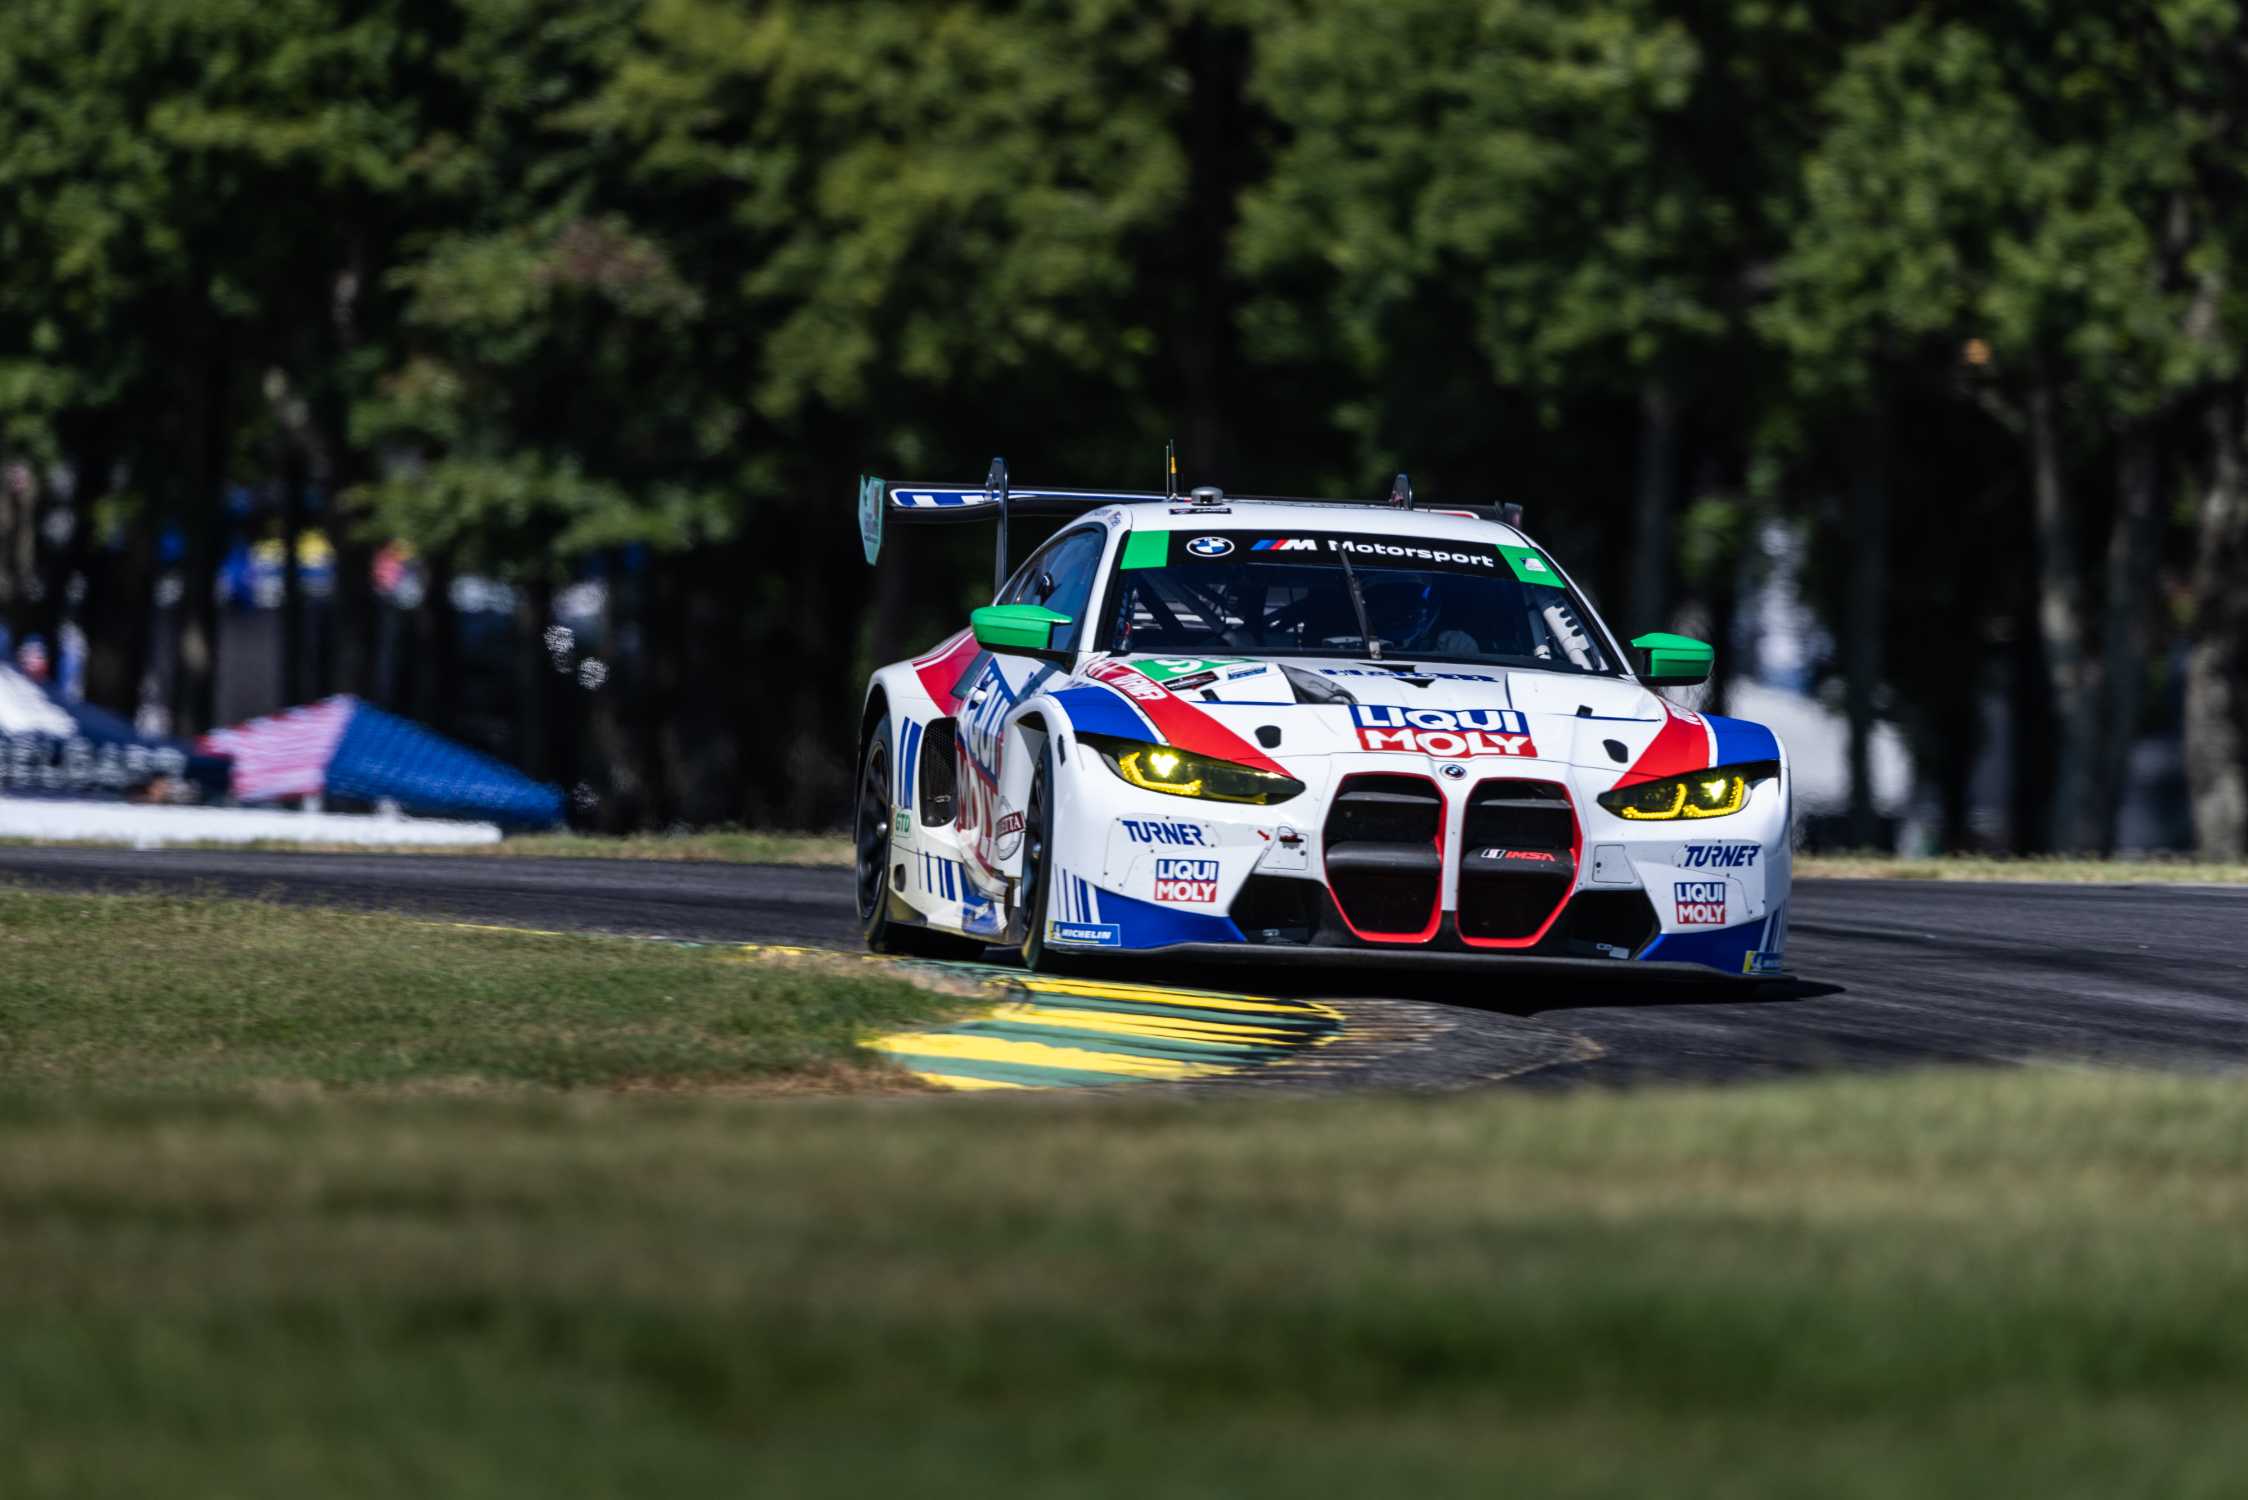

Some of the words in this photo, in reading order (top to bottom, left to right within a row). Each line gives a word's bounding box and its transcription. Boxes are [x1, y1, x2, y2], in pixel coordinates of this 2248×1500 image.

[1327, 540, 1494, 568] Motorsport
[1357, 704, 1522, 734] LIQUI
[1364, 727, 1530, 757] MOLY
[895, 812, 911, 833] GTD
[1121, 820, 1206, 846] TURNER
[1505, 850, 1555, 862] IMSA
[1684, 845, 1762, 868] TURNER
[1158, 860, 1217, 881] LIQUI
[1156, 880, 1217, 901] MOLY
[1676, 883, 1724, 903] LIQUI
[1678, 904, 1724, 923] MOLY
[1061, 928, 1113, 940] MICHELIN
